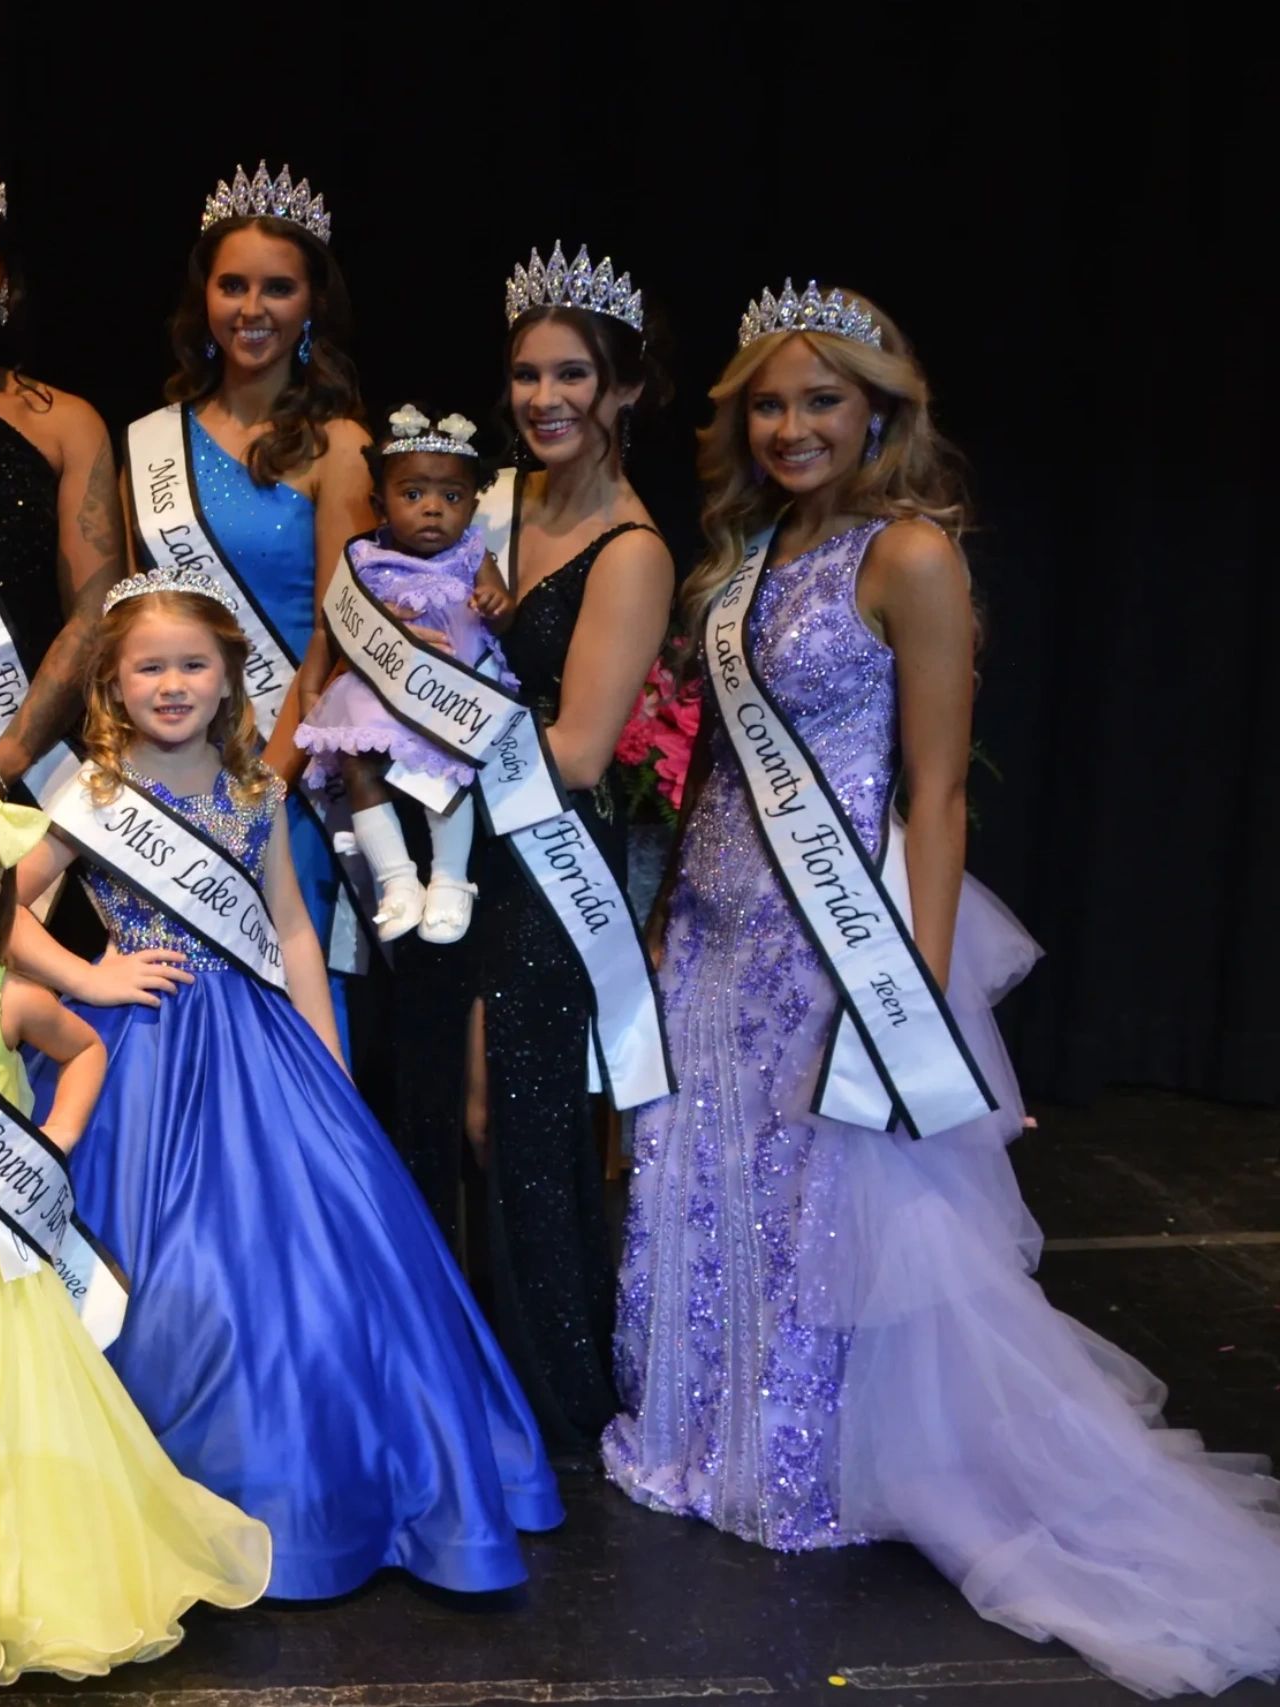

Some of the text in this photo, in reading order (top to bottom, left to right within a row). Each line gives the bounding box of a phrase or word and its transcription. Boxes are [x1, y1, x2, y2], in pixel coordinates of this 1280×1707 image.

[147, 458, 176, 514] Miss
[158, 524, 214, 585] Lak
[333, 585, 366, 638] Miss
[361, 626, 405, 682] Lake
[404, 663, 494, 746] County
[498, 736, 528, 784] Baby
[531, 819, 618, 937] Florida
[712, 622, 743, 692] Lake
[736, 702, 806, 819] County
[792, 822, 875, 949] Florida
[870, 971, 908, 1028] Teen
[104, 806, 282, 968] Miss Lake Count
